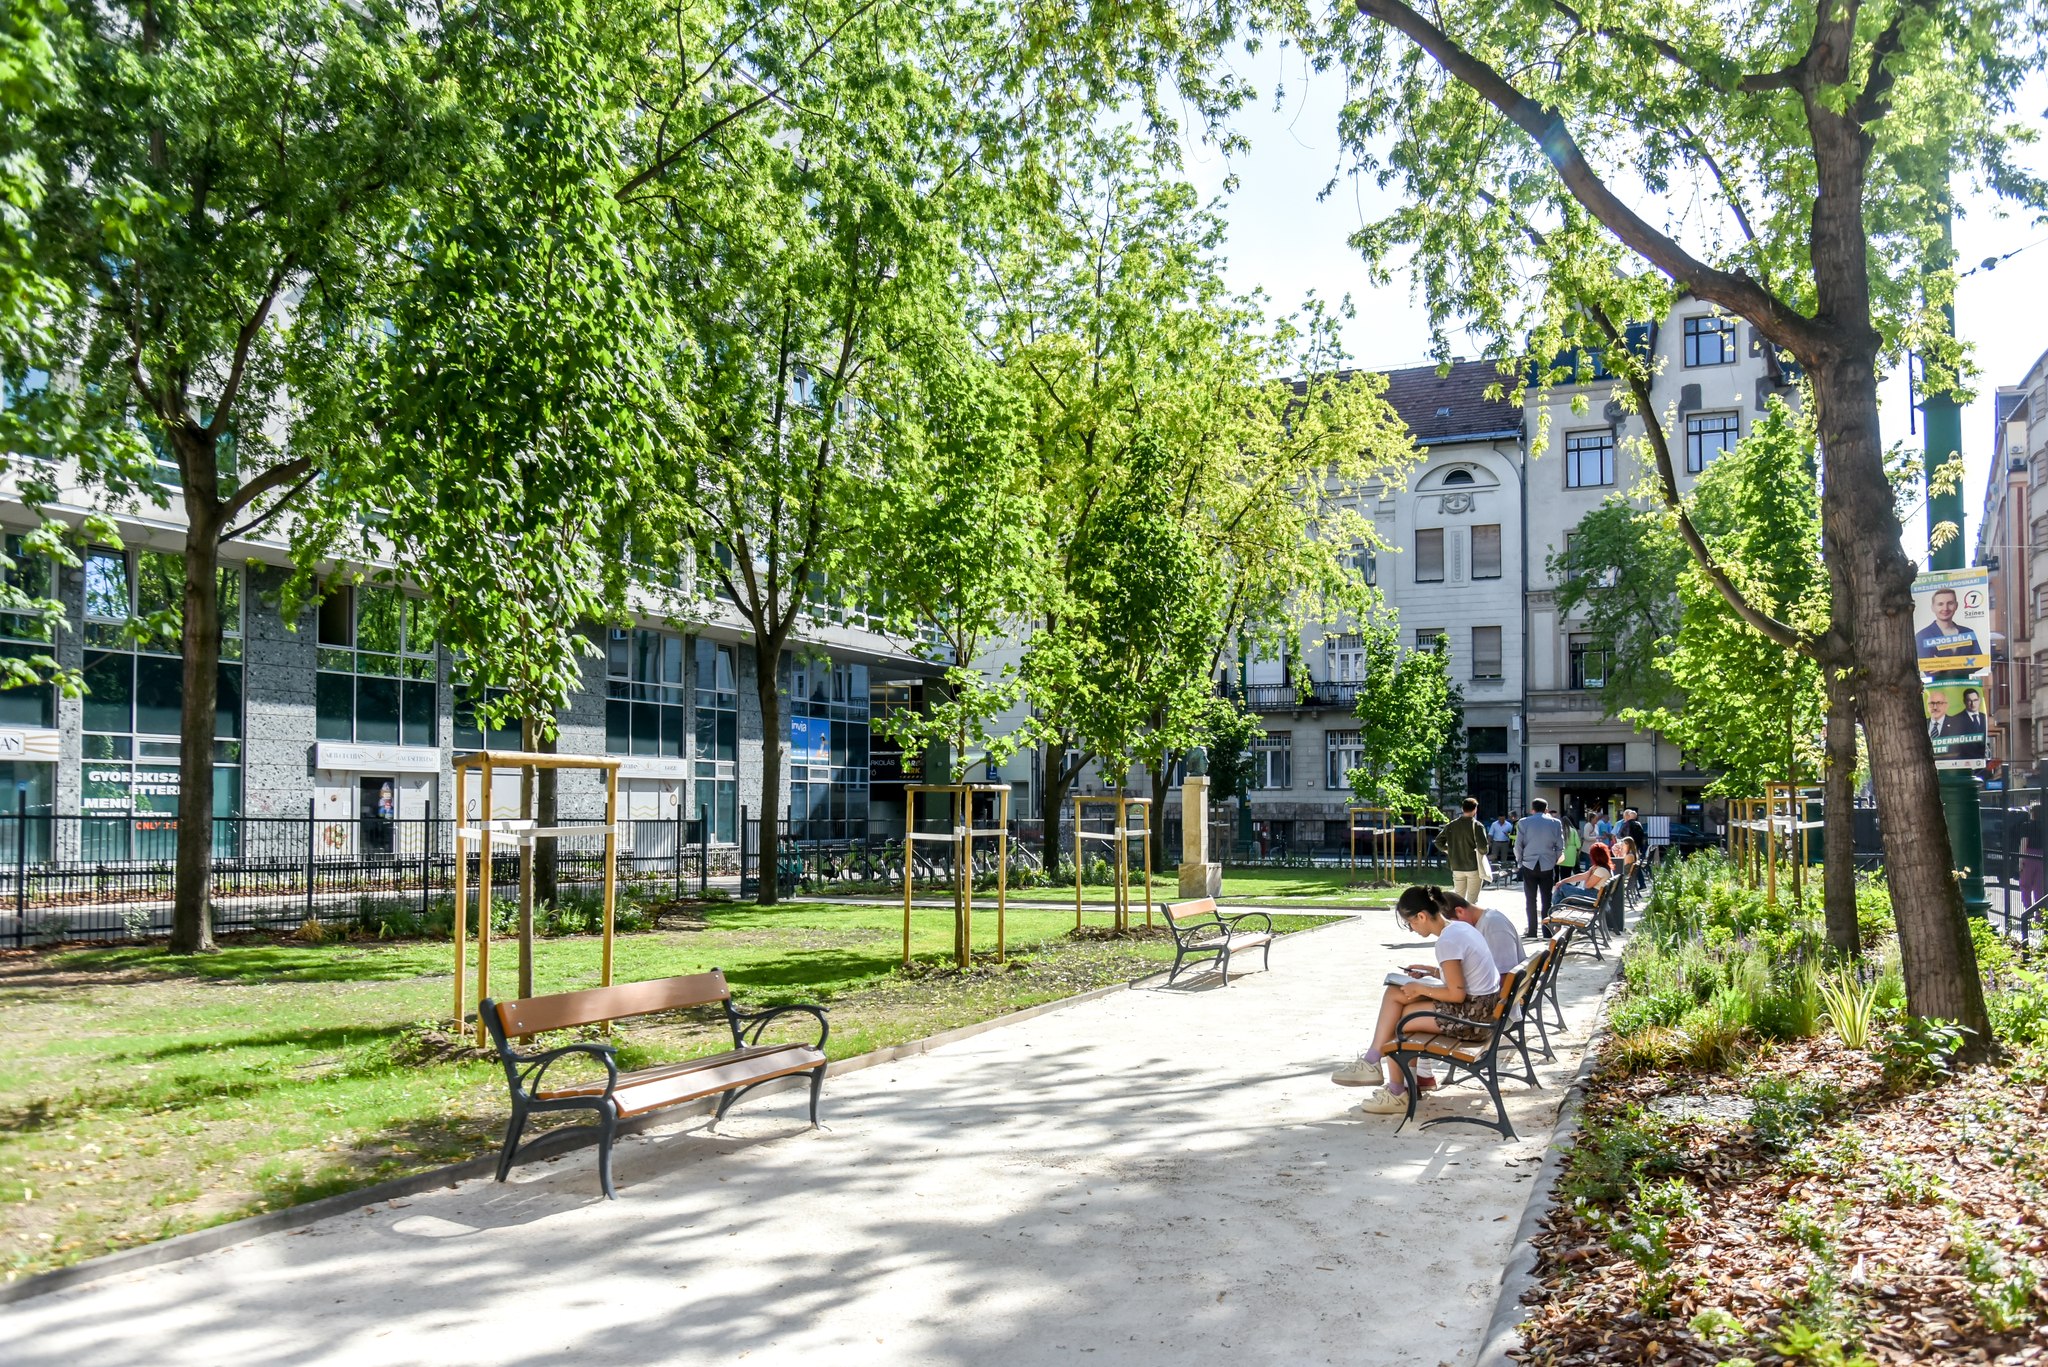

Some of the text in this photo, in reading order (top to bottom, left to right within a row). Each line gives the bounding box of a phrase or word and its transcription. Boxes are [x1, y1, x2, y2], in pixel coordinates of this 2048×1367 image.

[1915, 574, 1944, 584] EGYEN
[1970, 595, 1977, 604] 7
[1926, 636, 1952, 646] LAJOS
[1952, 634, 1972, 643] BÉLA
[791, 720, 807, 732] invia
[1932, 734, 1983, 746] EDERMÜLLER
[88, 771, 181, 782] GYORSKISZ
